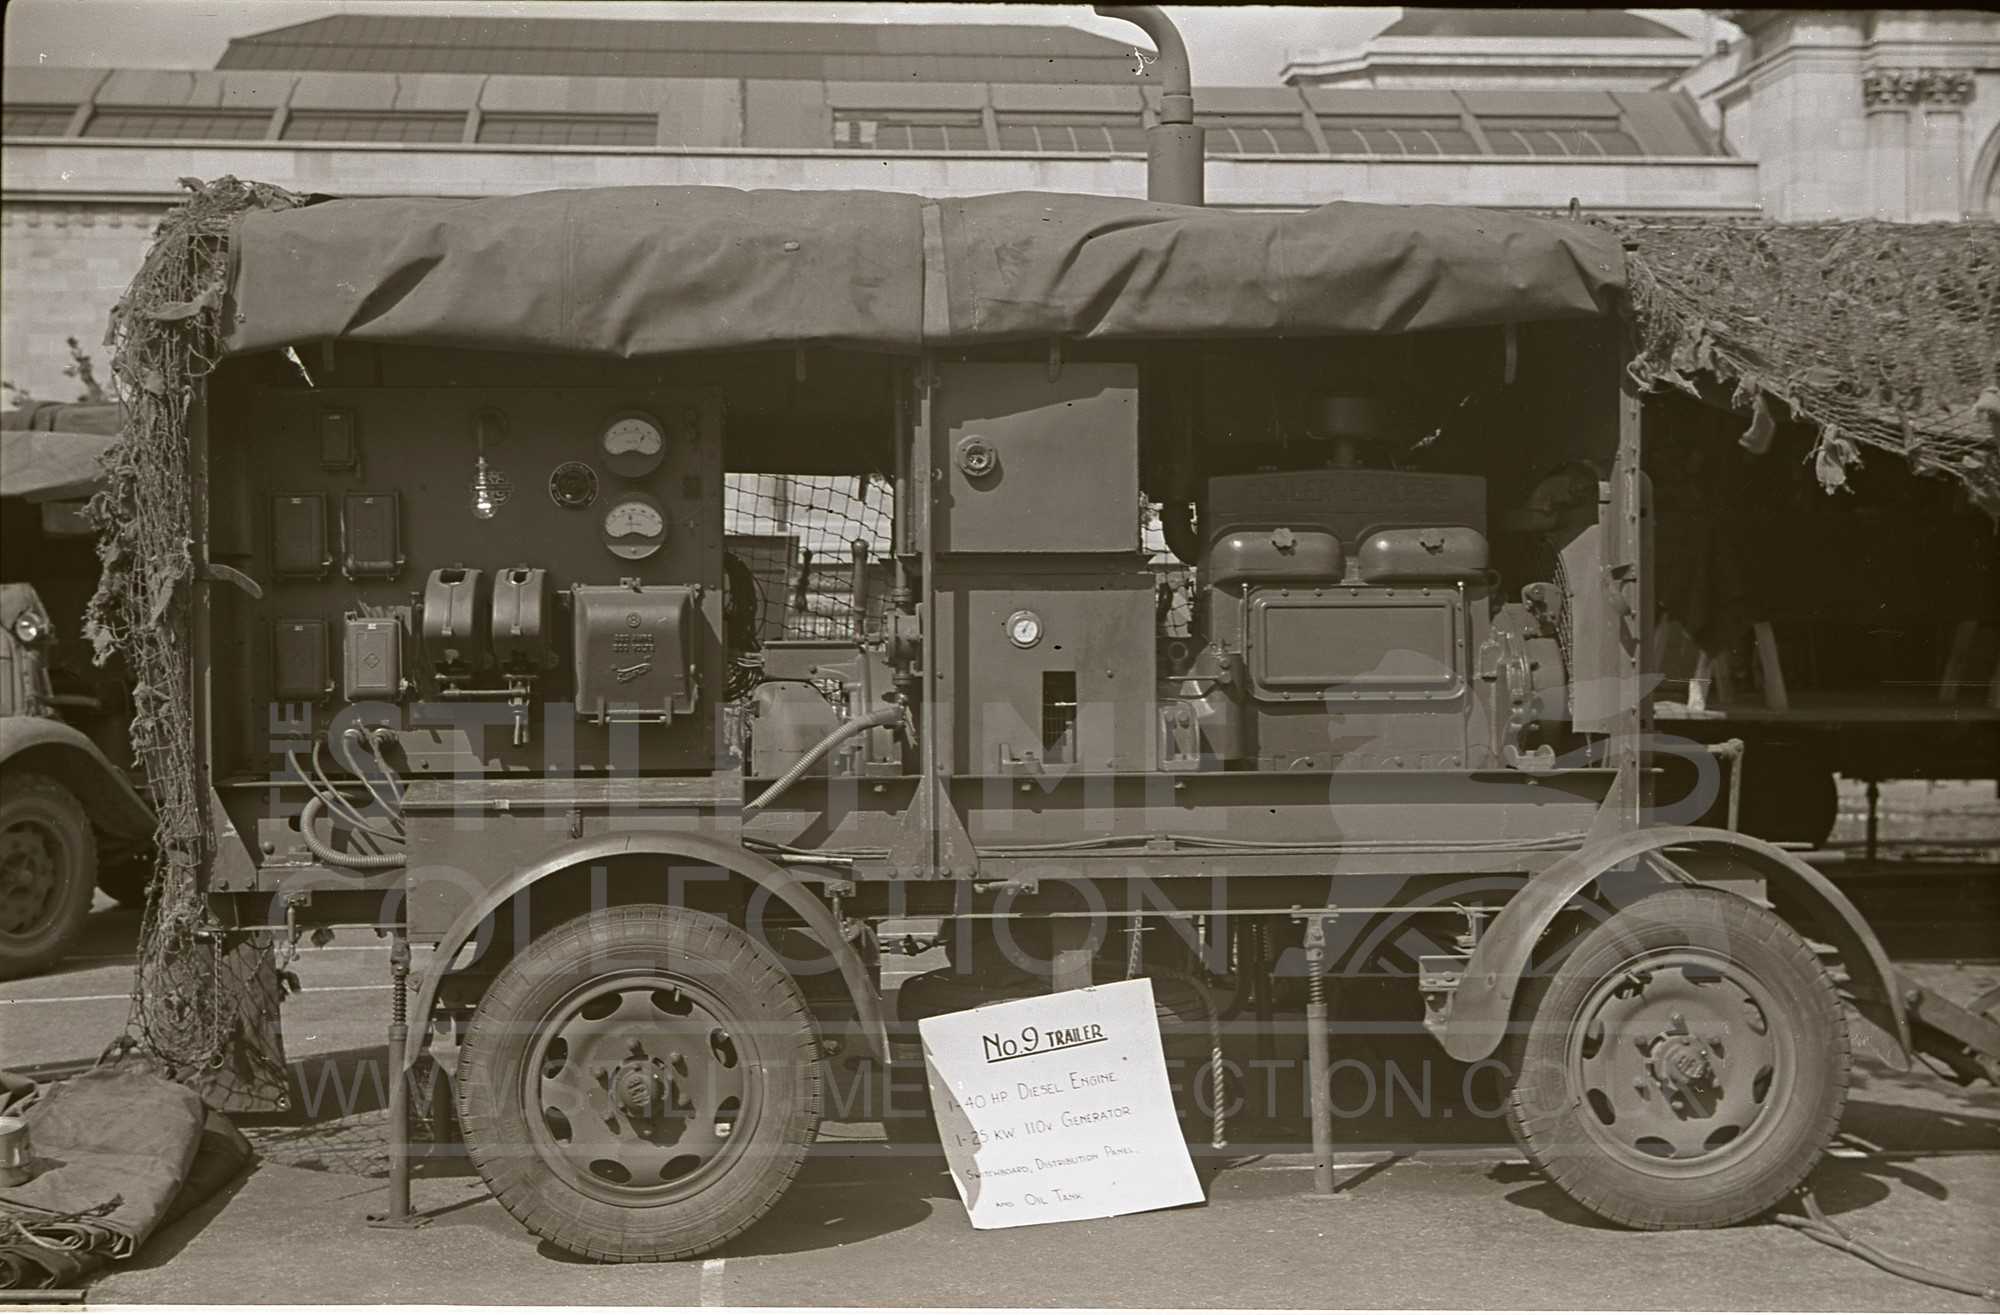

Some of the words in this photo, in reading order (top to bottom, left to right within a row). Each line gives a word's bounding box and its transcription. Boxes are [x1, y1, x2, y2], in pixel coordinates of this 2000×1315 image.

[1045, 1023, 1104, 1048] TRAILER
[990, 1091, 1009, 1104] HP
[1016, 1083, 1064, 1101] DIESEL
[1069, 1071, 1119, 1090] ENGINE
[1060, 1105, 1132, 1128] GENERATOR
